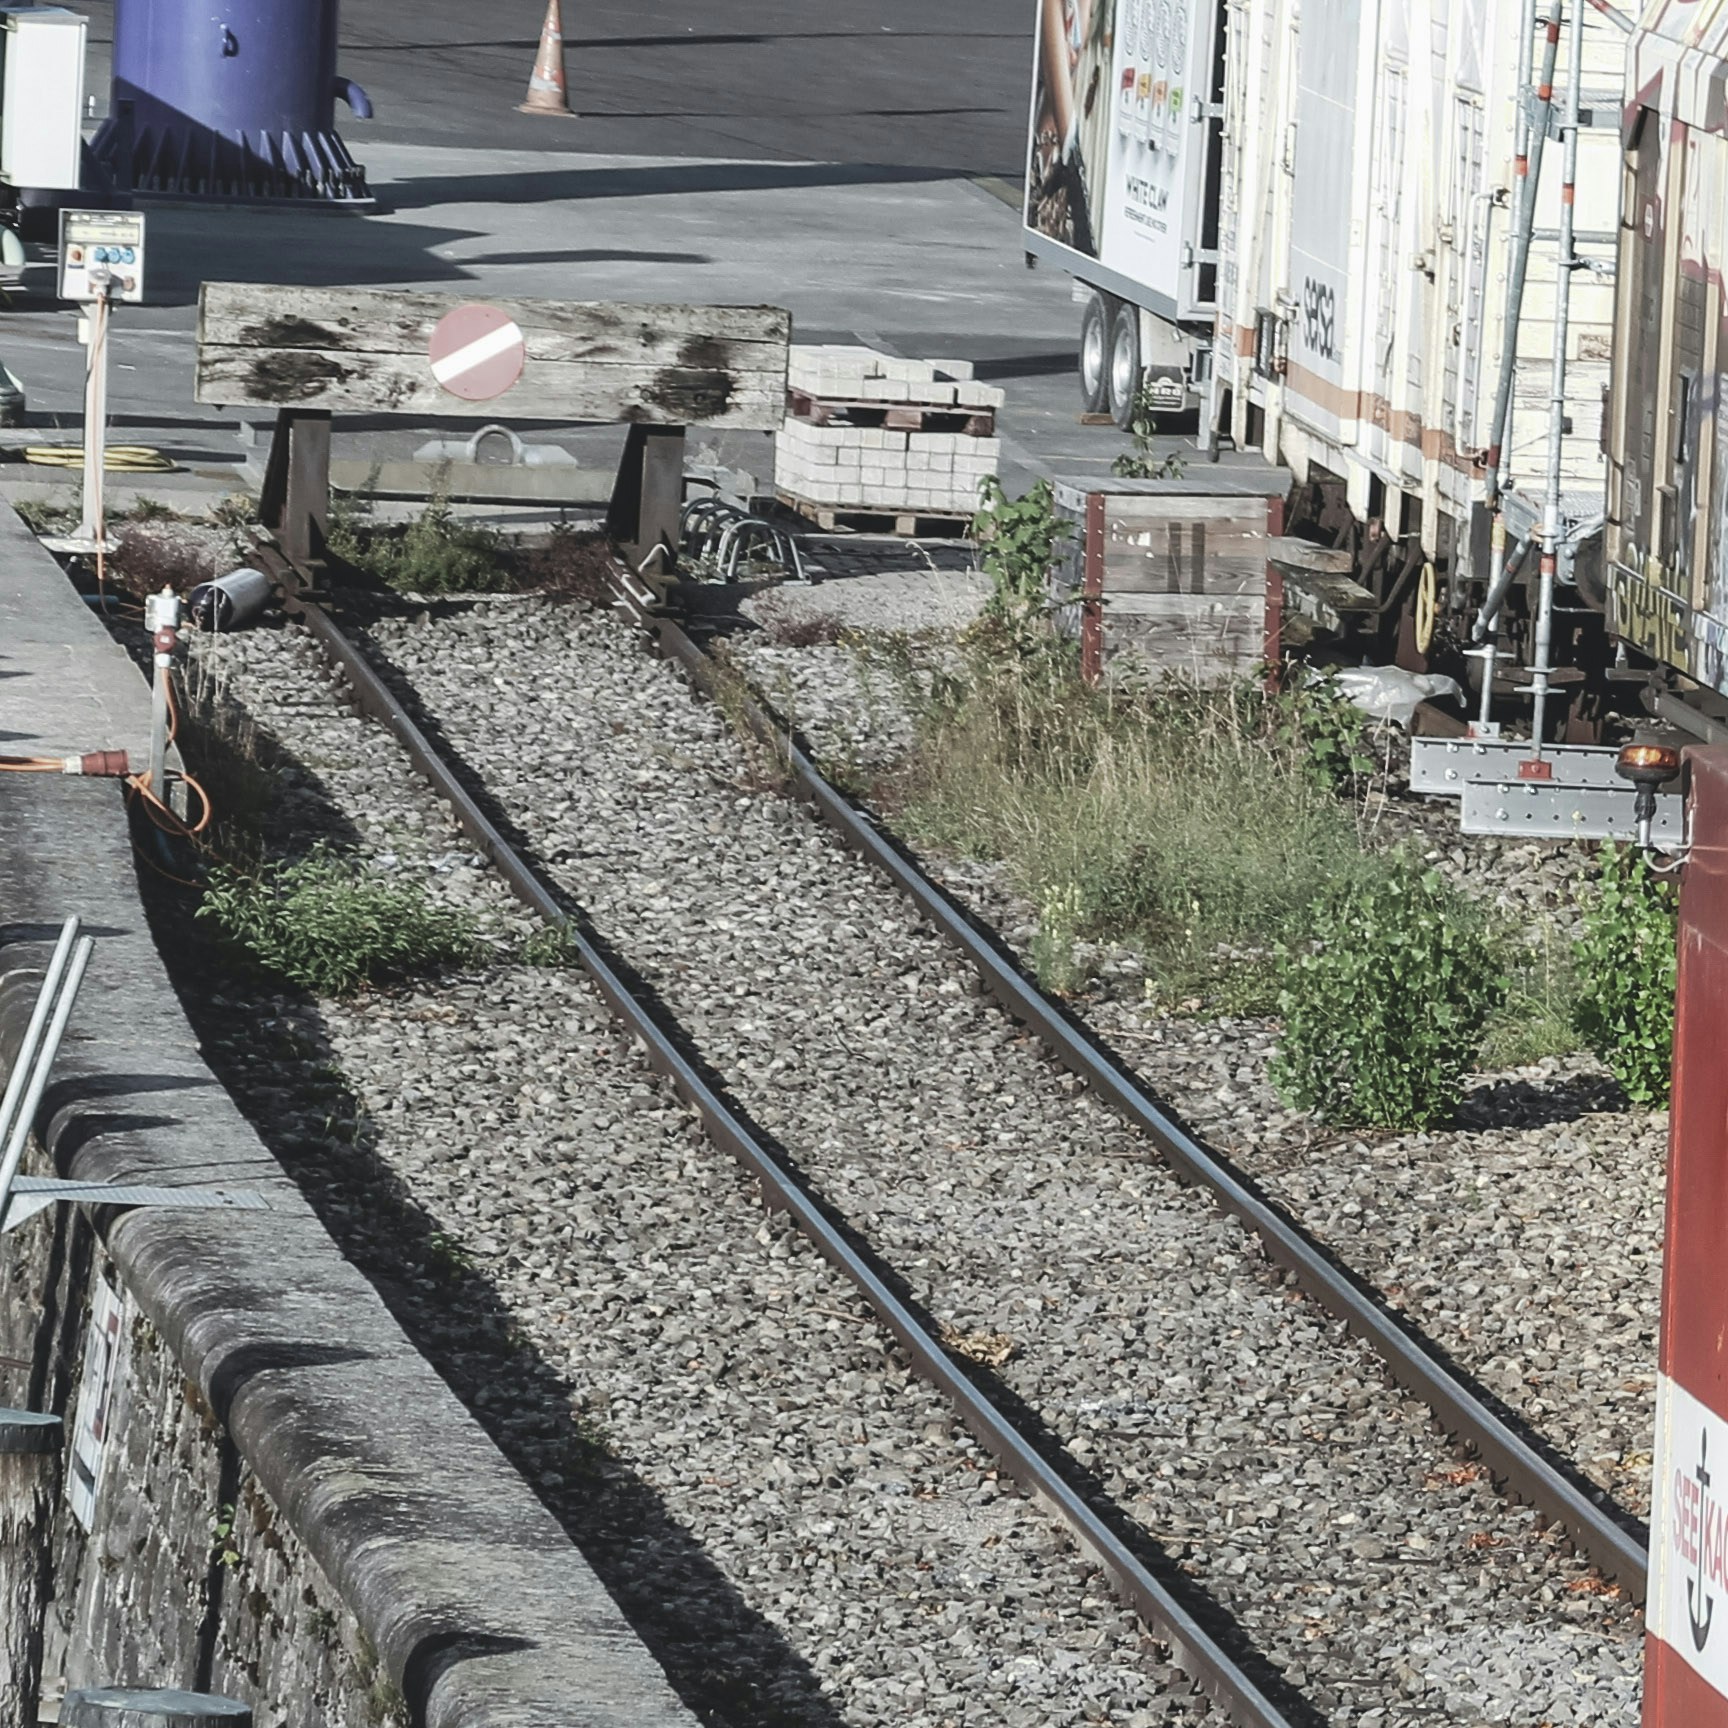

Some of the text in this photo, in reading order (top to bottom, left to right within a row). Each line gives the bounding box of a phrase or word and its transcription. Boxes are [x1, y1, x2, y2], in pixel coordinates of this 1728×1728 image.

[1126, 174, 1169, 212] WHITE CLAW
[1304, 275, 1334, 359] sersa
